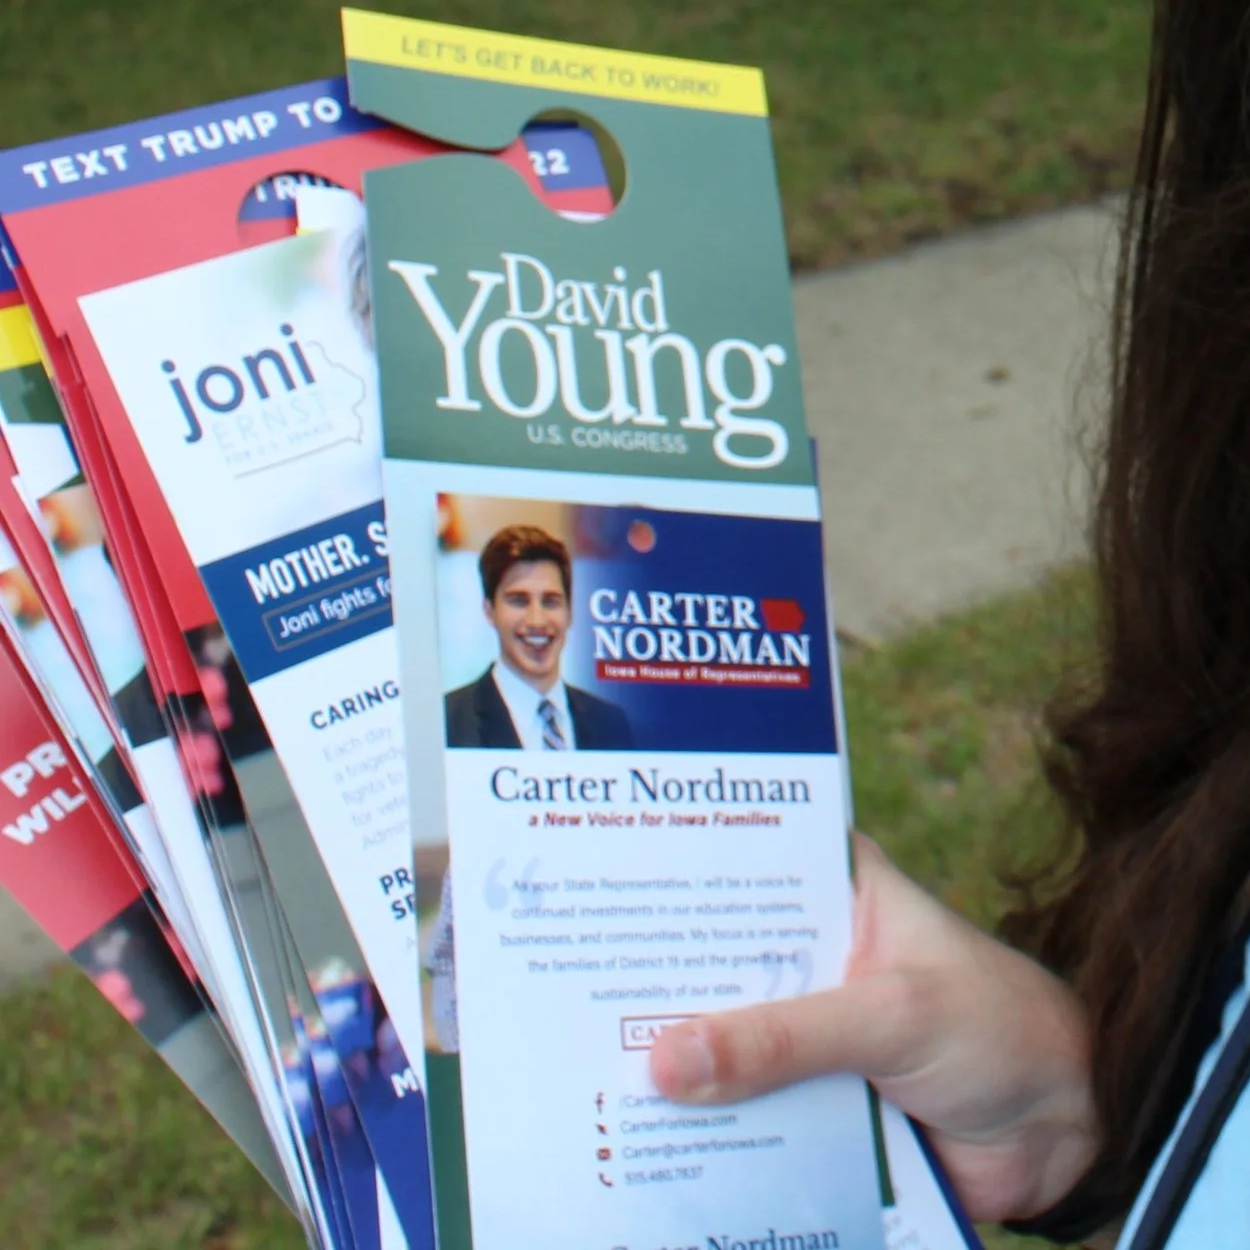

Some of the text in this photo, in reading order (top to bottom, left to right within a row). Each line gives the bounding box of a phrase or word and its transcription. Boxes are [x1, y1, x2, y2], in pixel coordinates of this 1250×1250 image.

[402, 35, 720, 96] LET'S GET BACK TO WORK!
[23, 97, 342, 189] TEXT TRUMP TO
[502, 252, 668, 333] David
[161, 323, 316, 443] joni
[388, 260, 788, 469] Young
[212, 389, 327, 450] ERNST
[527, 424, 689, 455] U.S. CONGRESS
[245, 533, 370, 604] MOTHER.
[320, 586, 377, 620] fights
[590, 588, 760, 630] CARTER
[593, 625, 811, 667] NORDMAN
[604, 664, 801, 684] Iowa House of Representatives
[310, 680, 400, 730] CARING
[490, 765, 813, 803] Carter Nordman
[529, 811, 783, 828] a New Voice for Iowa Families
